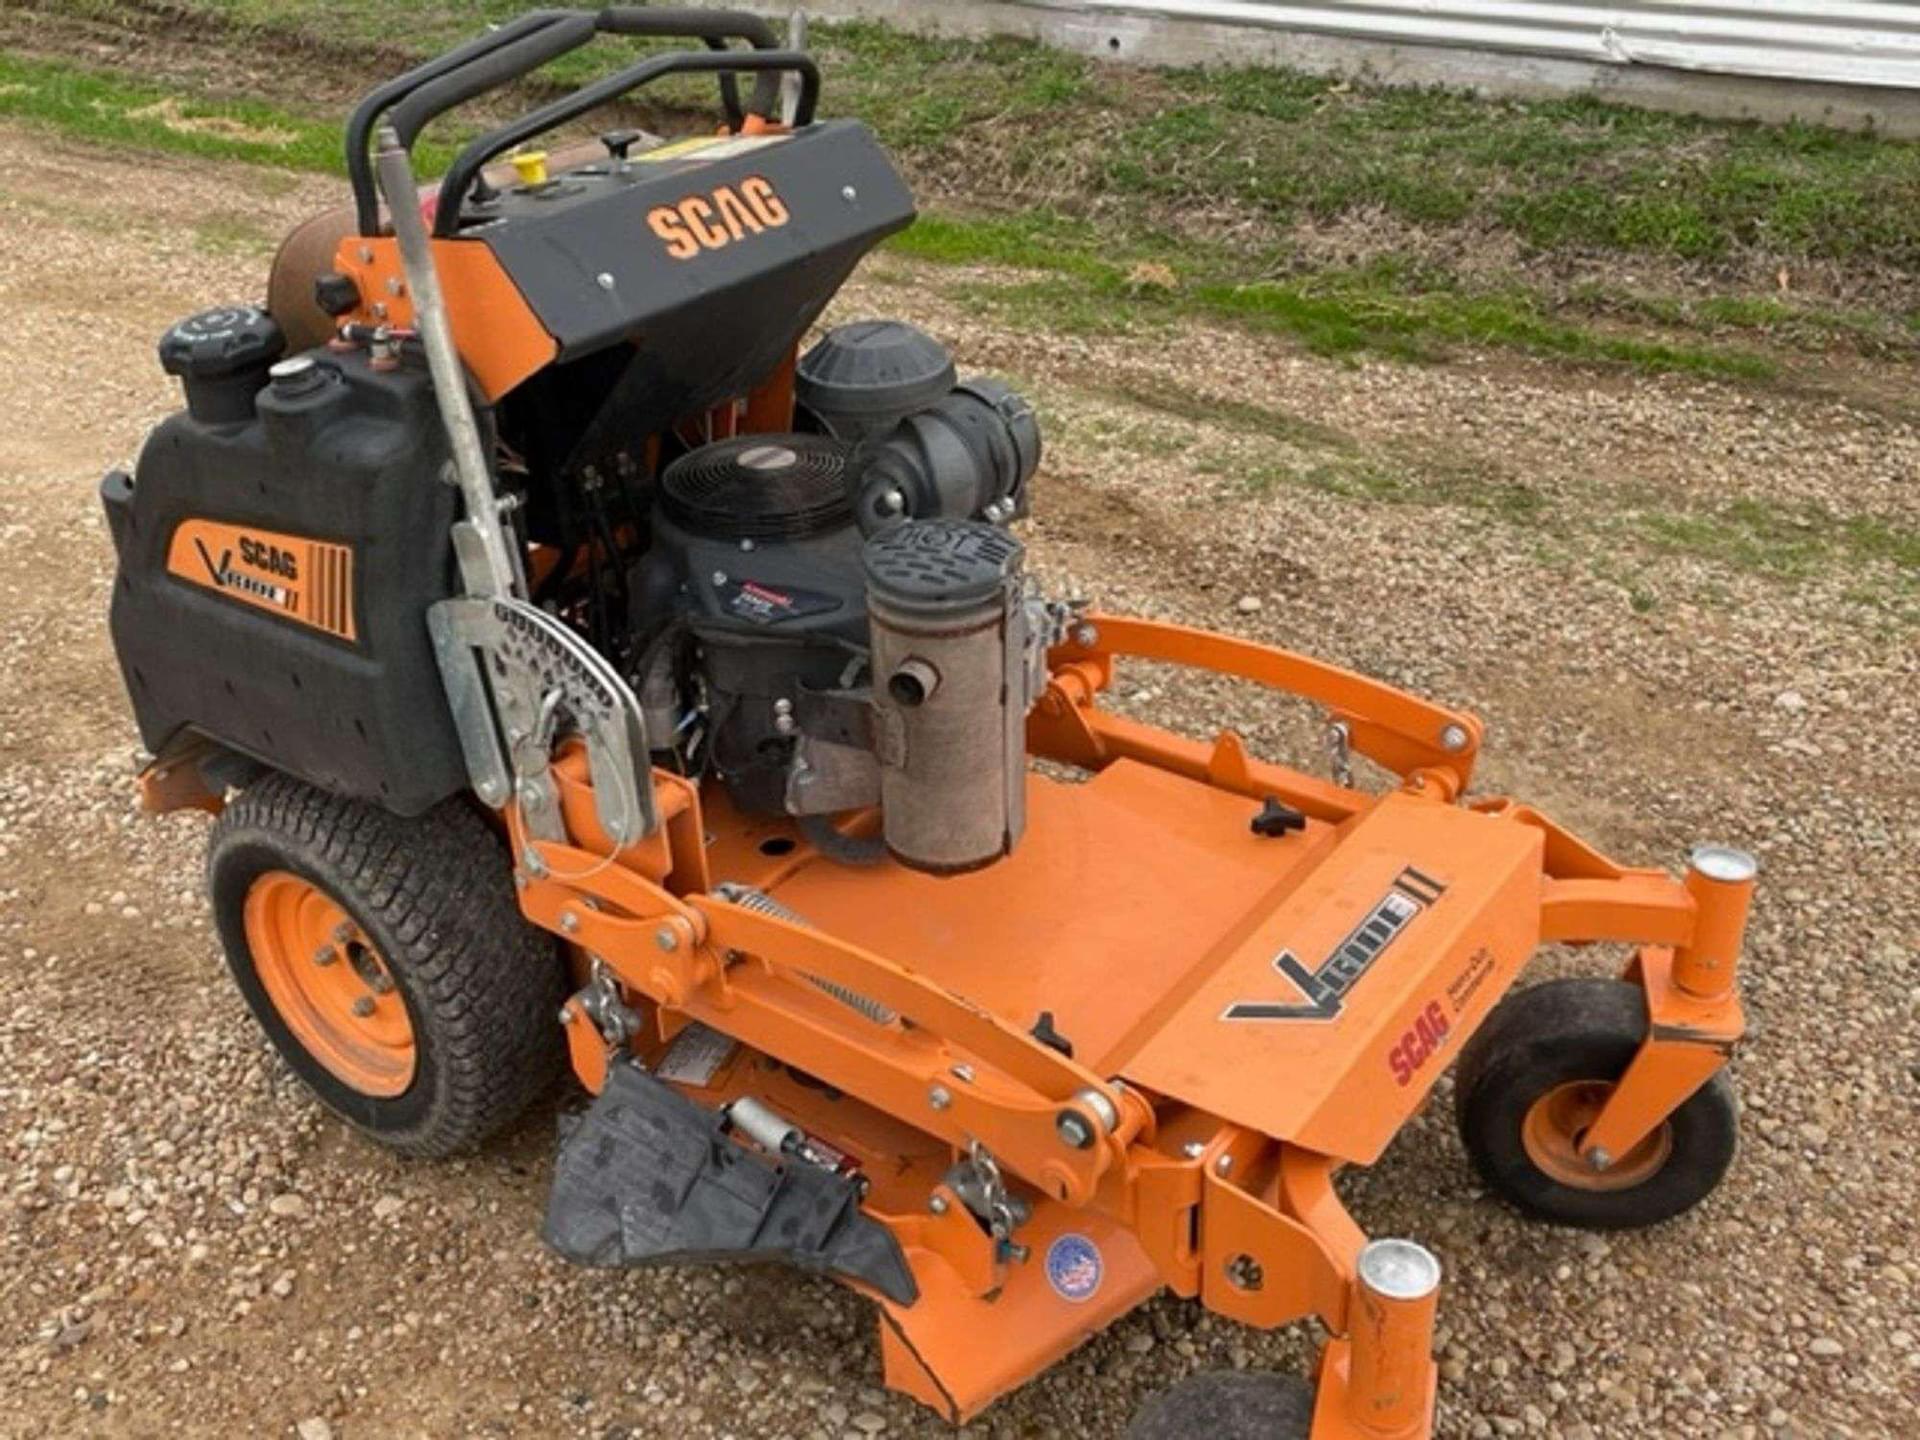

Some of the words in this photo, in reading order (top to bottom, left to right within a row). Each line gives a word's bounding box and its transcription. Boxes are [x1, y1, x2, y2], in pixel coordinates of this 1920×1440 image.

[646, 174, 791, 260] SCAG
[238, 535, 298, 581] SCAG
[1388, 1000, 1450, 1088] SCAG
